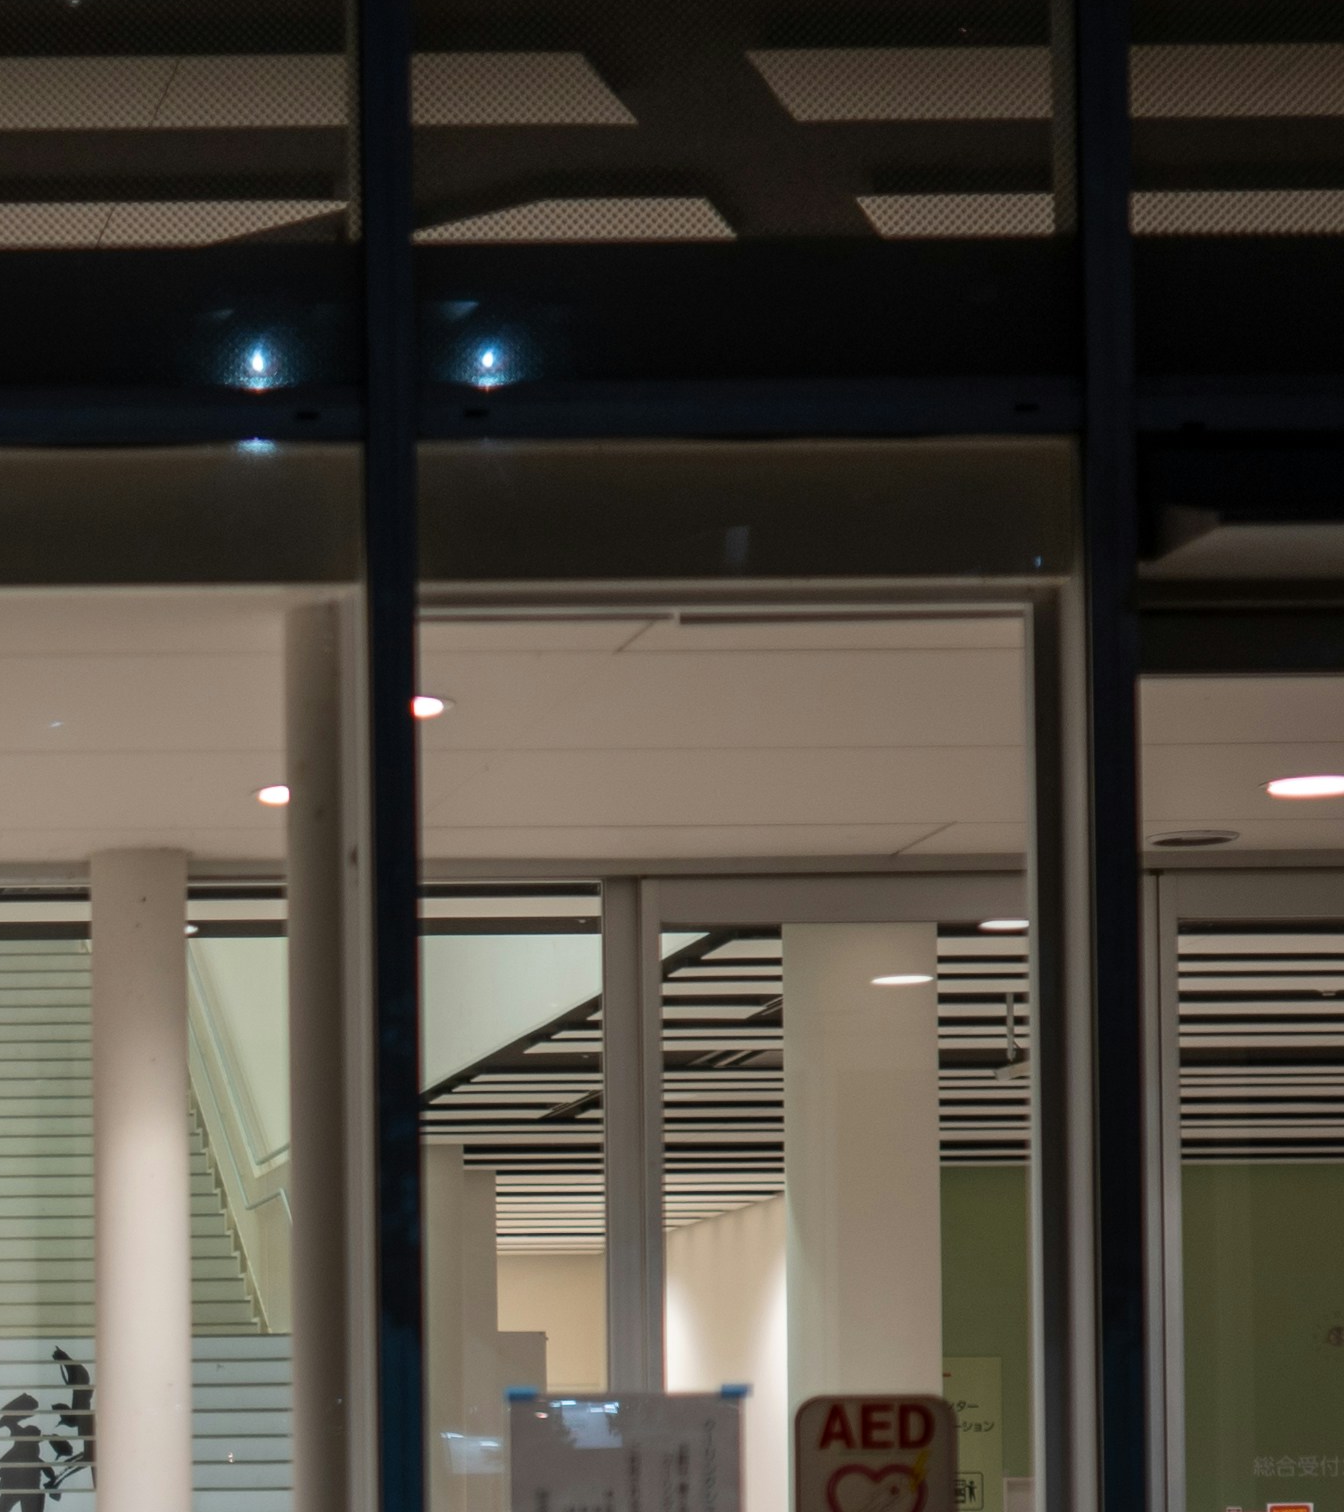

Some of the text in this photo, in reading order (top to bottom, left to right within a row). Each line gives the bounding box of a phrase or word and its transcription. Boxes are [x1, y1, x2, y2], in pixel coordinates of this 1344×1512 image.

[819, 1403, 936, 1450] AED
[1252, 1454, 1344, 1478] 総合受付
